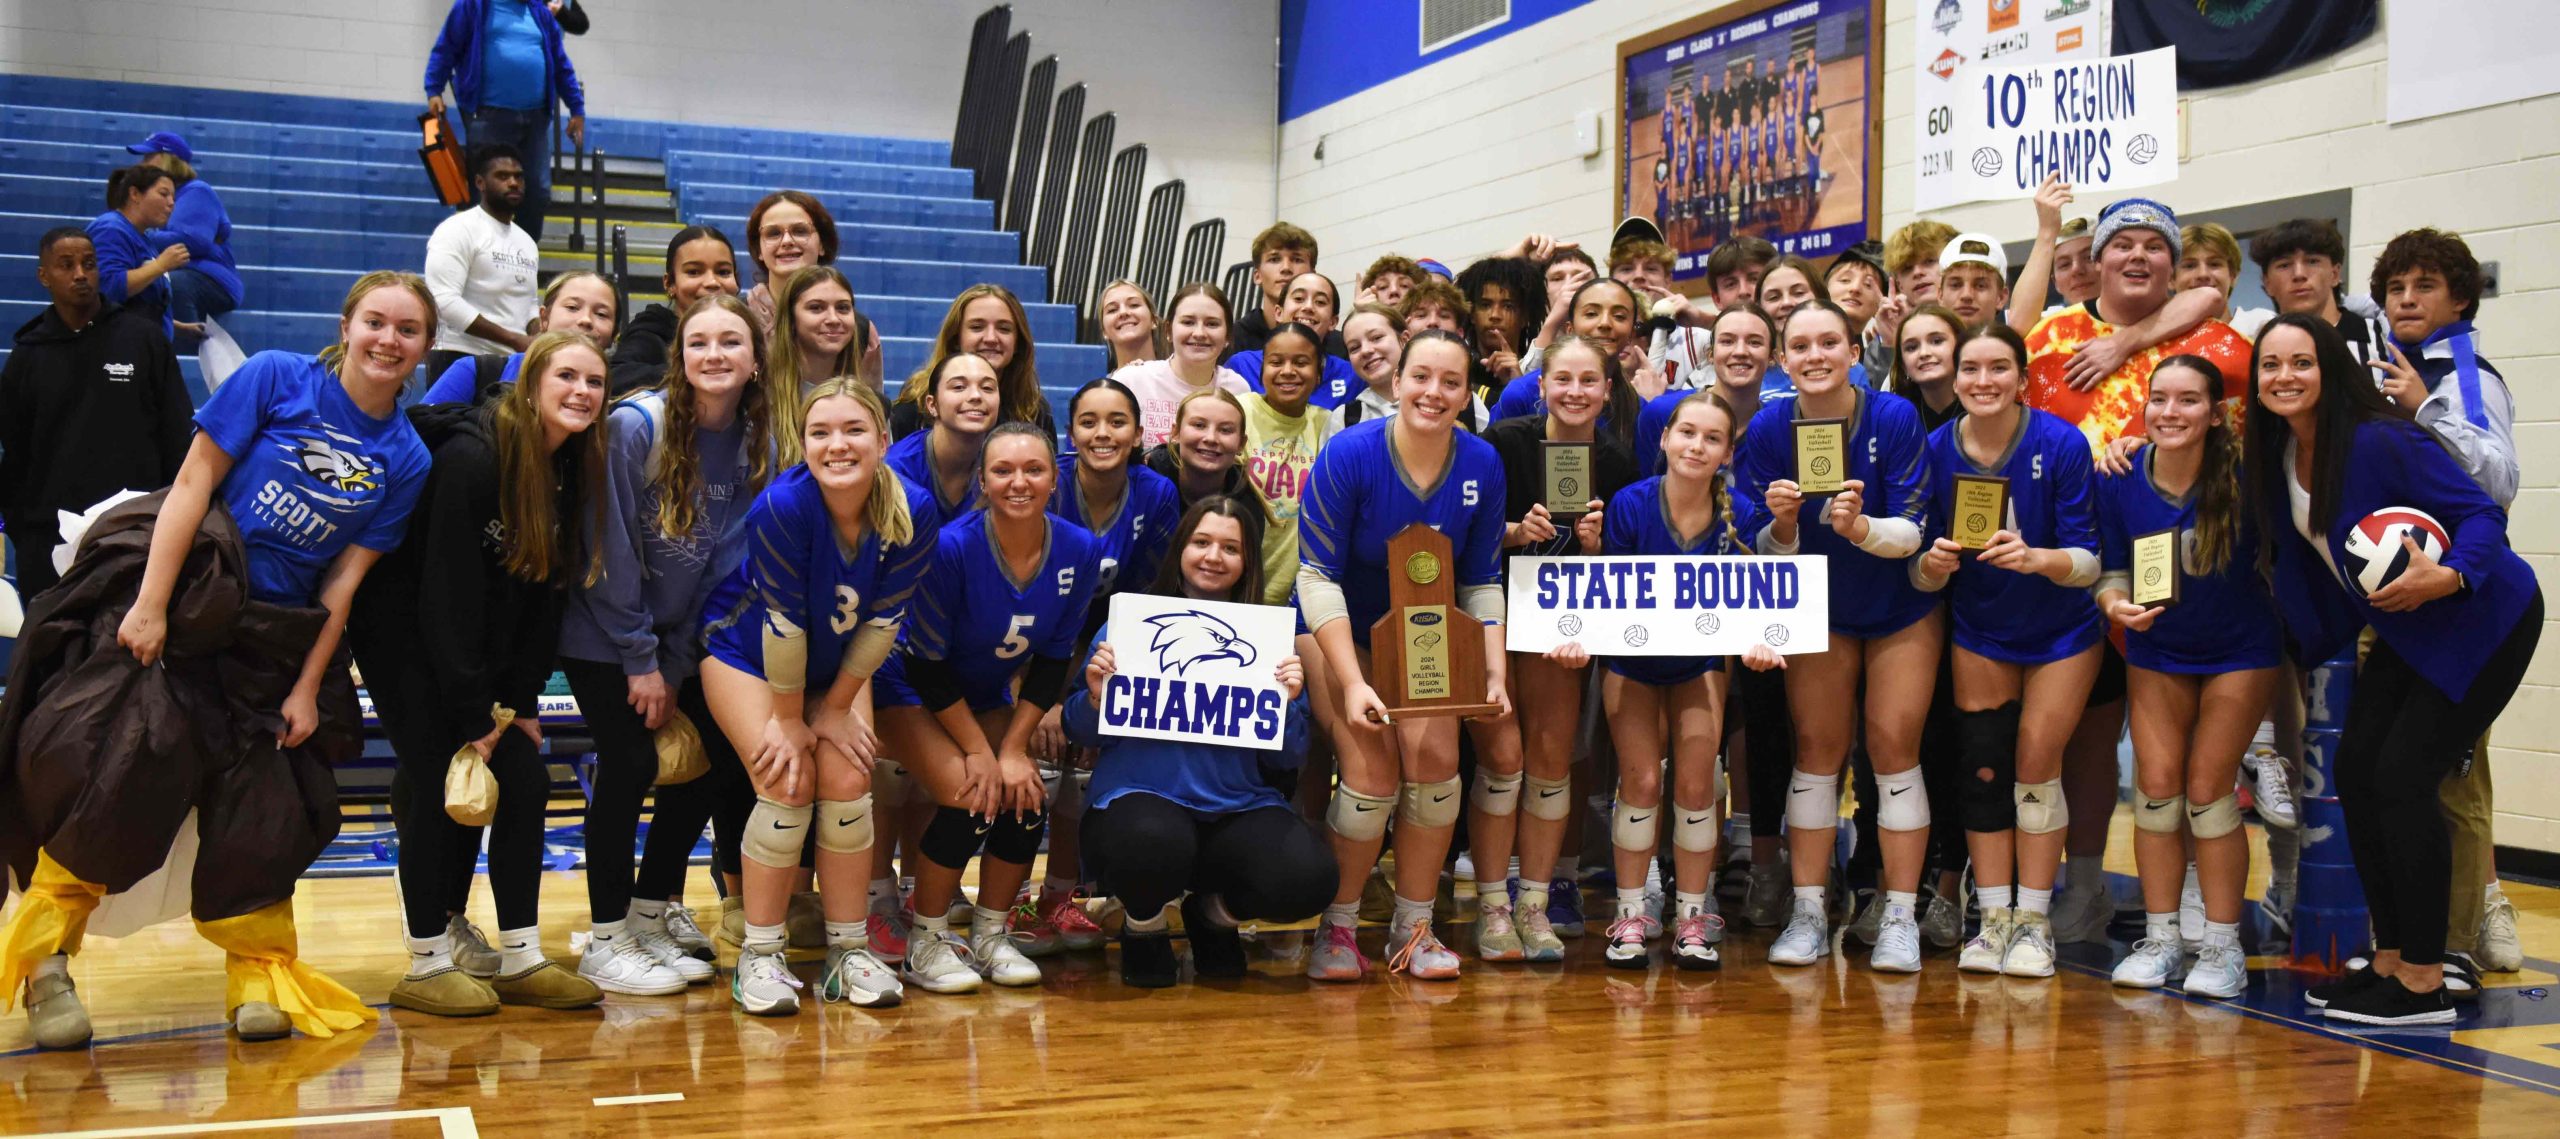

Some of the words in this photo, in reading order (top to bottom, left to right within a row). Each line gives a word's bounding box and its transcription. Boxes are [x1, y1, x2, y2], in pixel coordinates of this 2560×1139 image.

[1690, 36, 1714, 55] CLASS
[1730, 19, 1767, 42] REGIONAL
[1772, 1, 1820, 28] CHAMPIONS
[1982, 69, 2043, 129] 10th
[2055, 59, 2135, 124] REGION
[2016, 128, 2111, 189] CHAMPS
[1331, 379, 1347, 398] S
[2032, 454, 2042, 479] S
[257, 480, 338, 543] SCOTT
[1463, 480, 1479, 506] S
[1057, 566, 1075, 596] S
[1537, 562, 1657, 610] STATE
[1674, 562, 1799, 609] BOUND
[830, 584, 860, 635] 3
[995, 614, 1036, 659] 5
[1411, 671, 1445, 679] VOLLEYBALL
[1414, 687, 1444, 695] CHAMPION
[1105, 674, 1281, 741] CHAMPS
